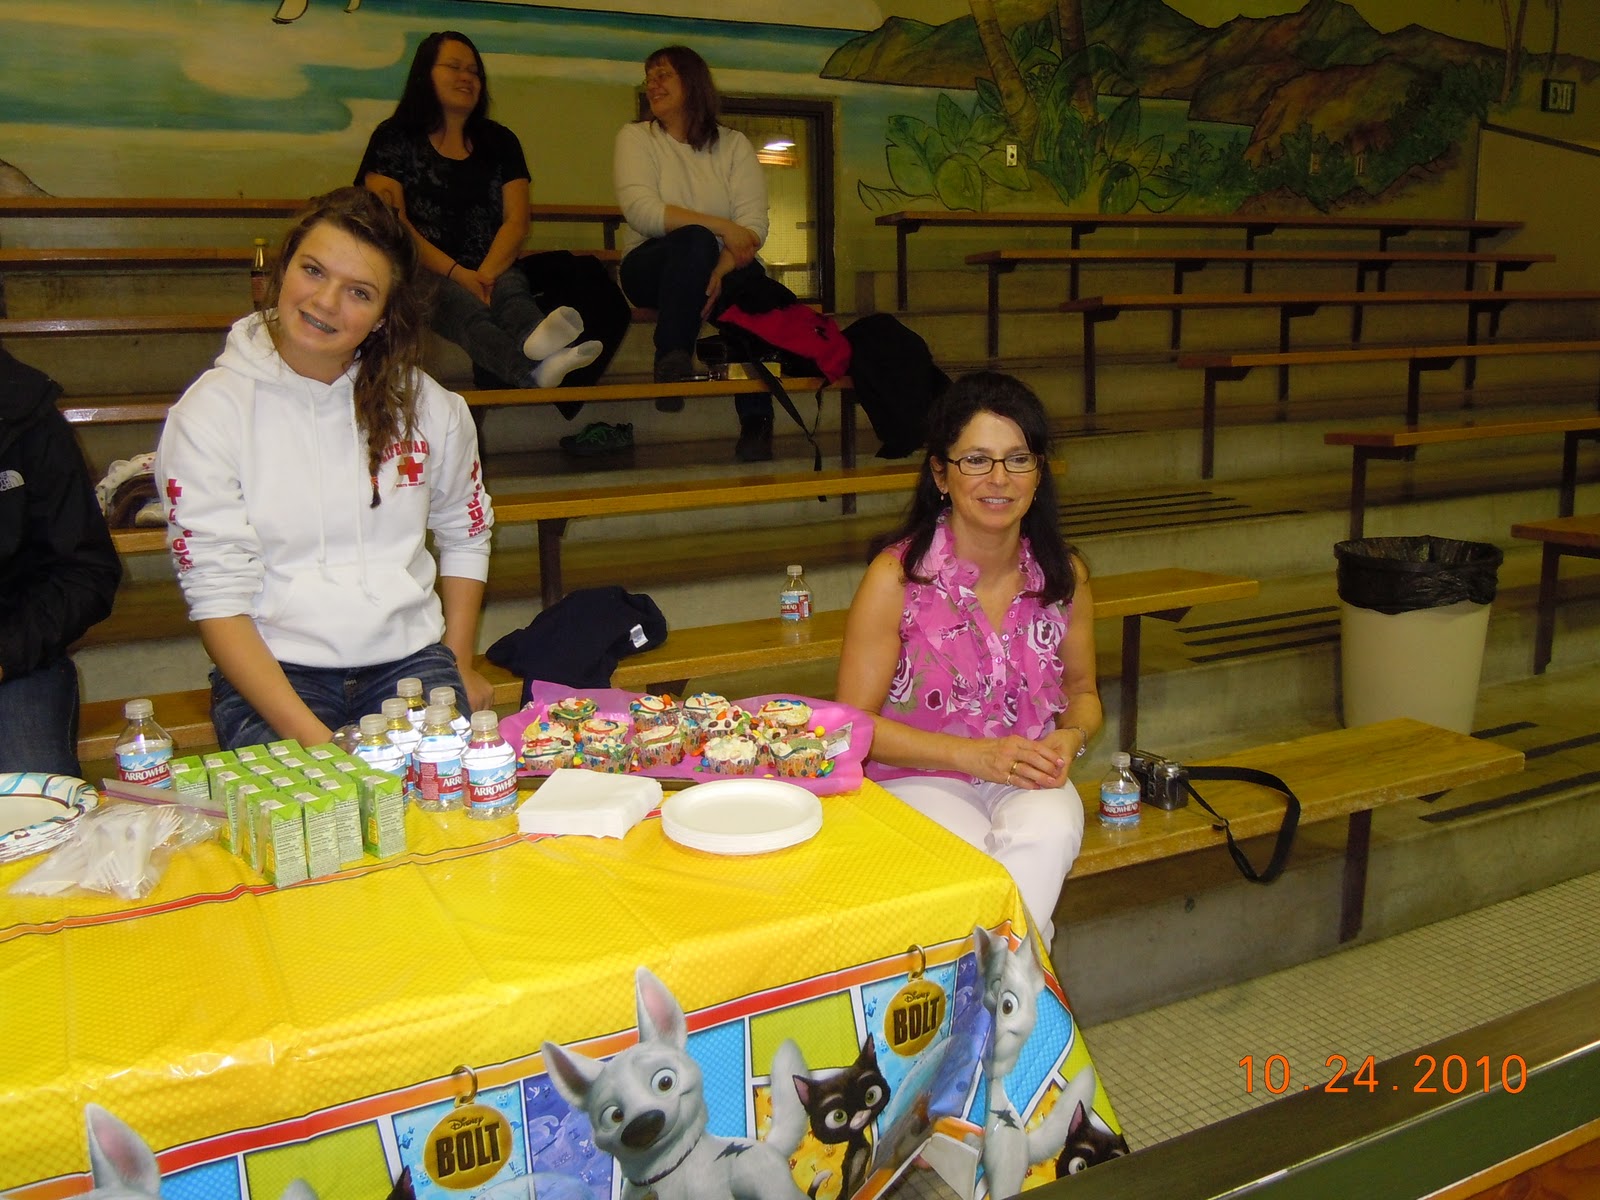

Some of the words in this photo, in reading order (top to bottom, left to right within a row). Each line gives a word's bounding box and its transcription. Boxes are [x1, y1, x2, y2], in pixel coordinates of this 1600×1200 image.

[124, 763, 170, 781] ARROWHEA
[473, 775, 517, 796] ARROWHEA
[893, 996, 940, 1046] BOLT
[436, 1122, 501, 1178] BOLT
